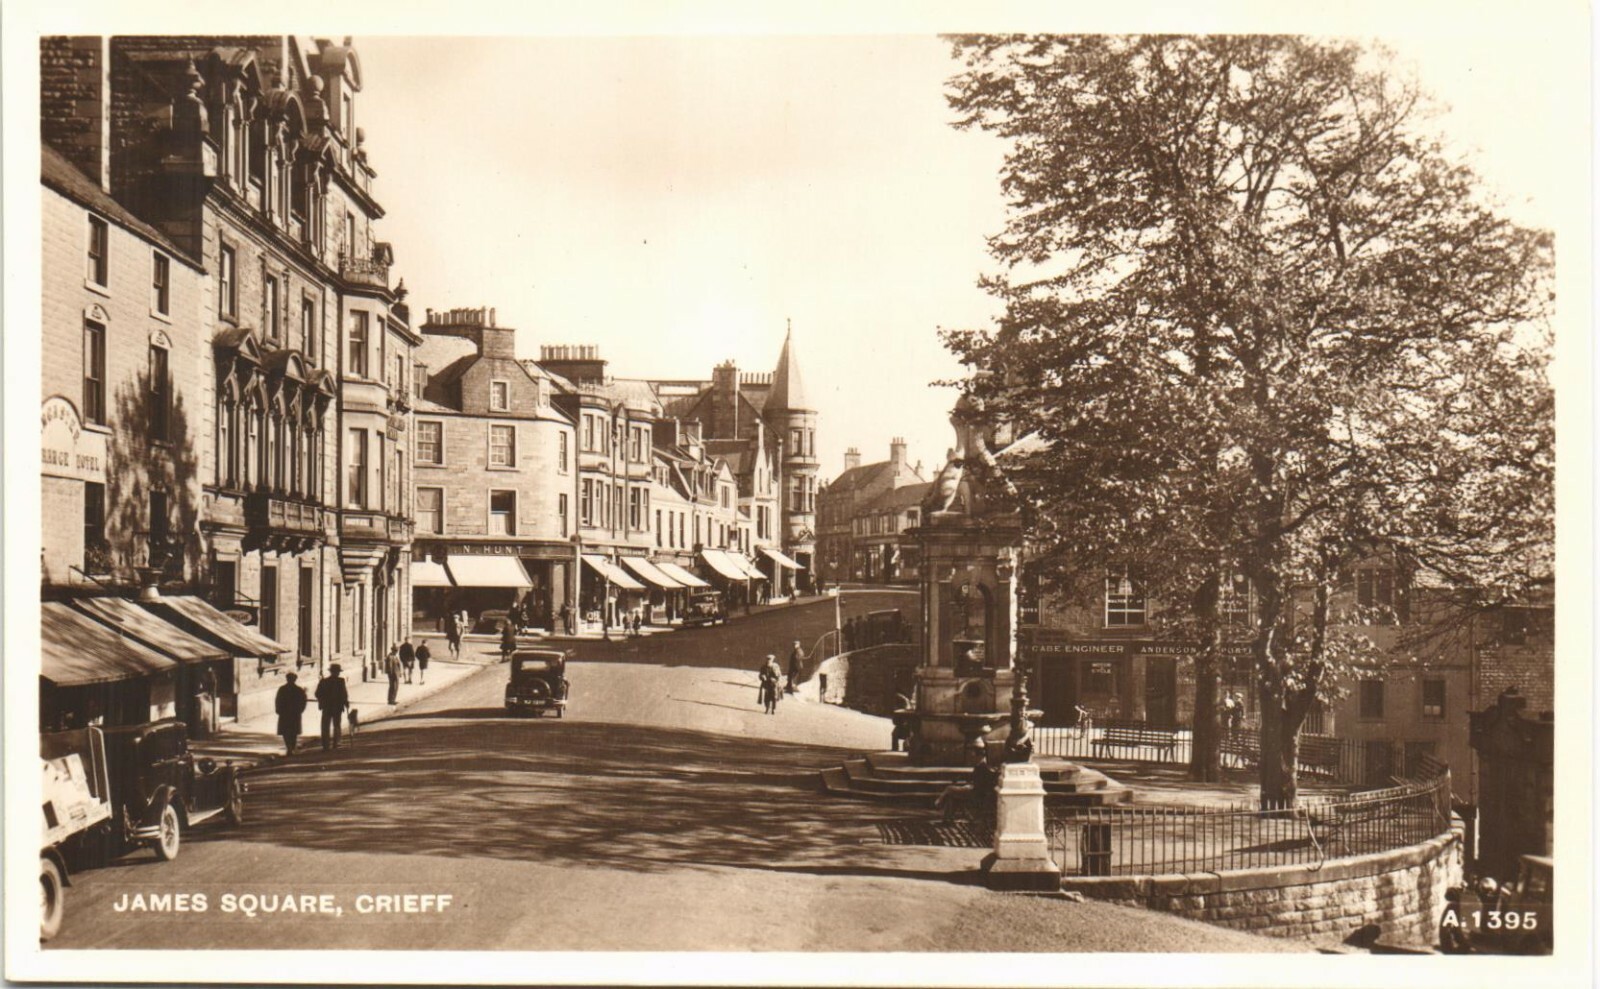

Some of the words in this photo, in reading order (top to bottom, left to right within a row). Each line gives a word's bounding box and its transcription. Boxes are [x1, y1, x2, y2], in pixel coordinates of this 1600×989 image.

[76, 453, 100, 472] HOTEL
[483, 545, 523, 554] HUNT
[1064, 645, 1125, 653] ENGINEER
[1140, 646, 1198, 654] ANDERSON
